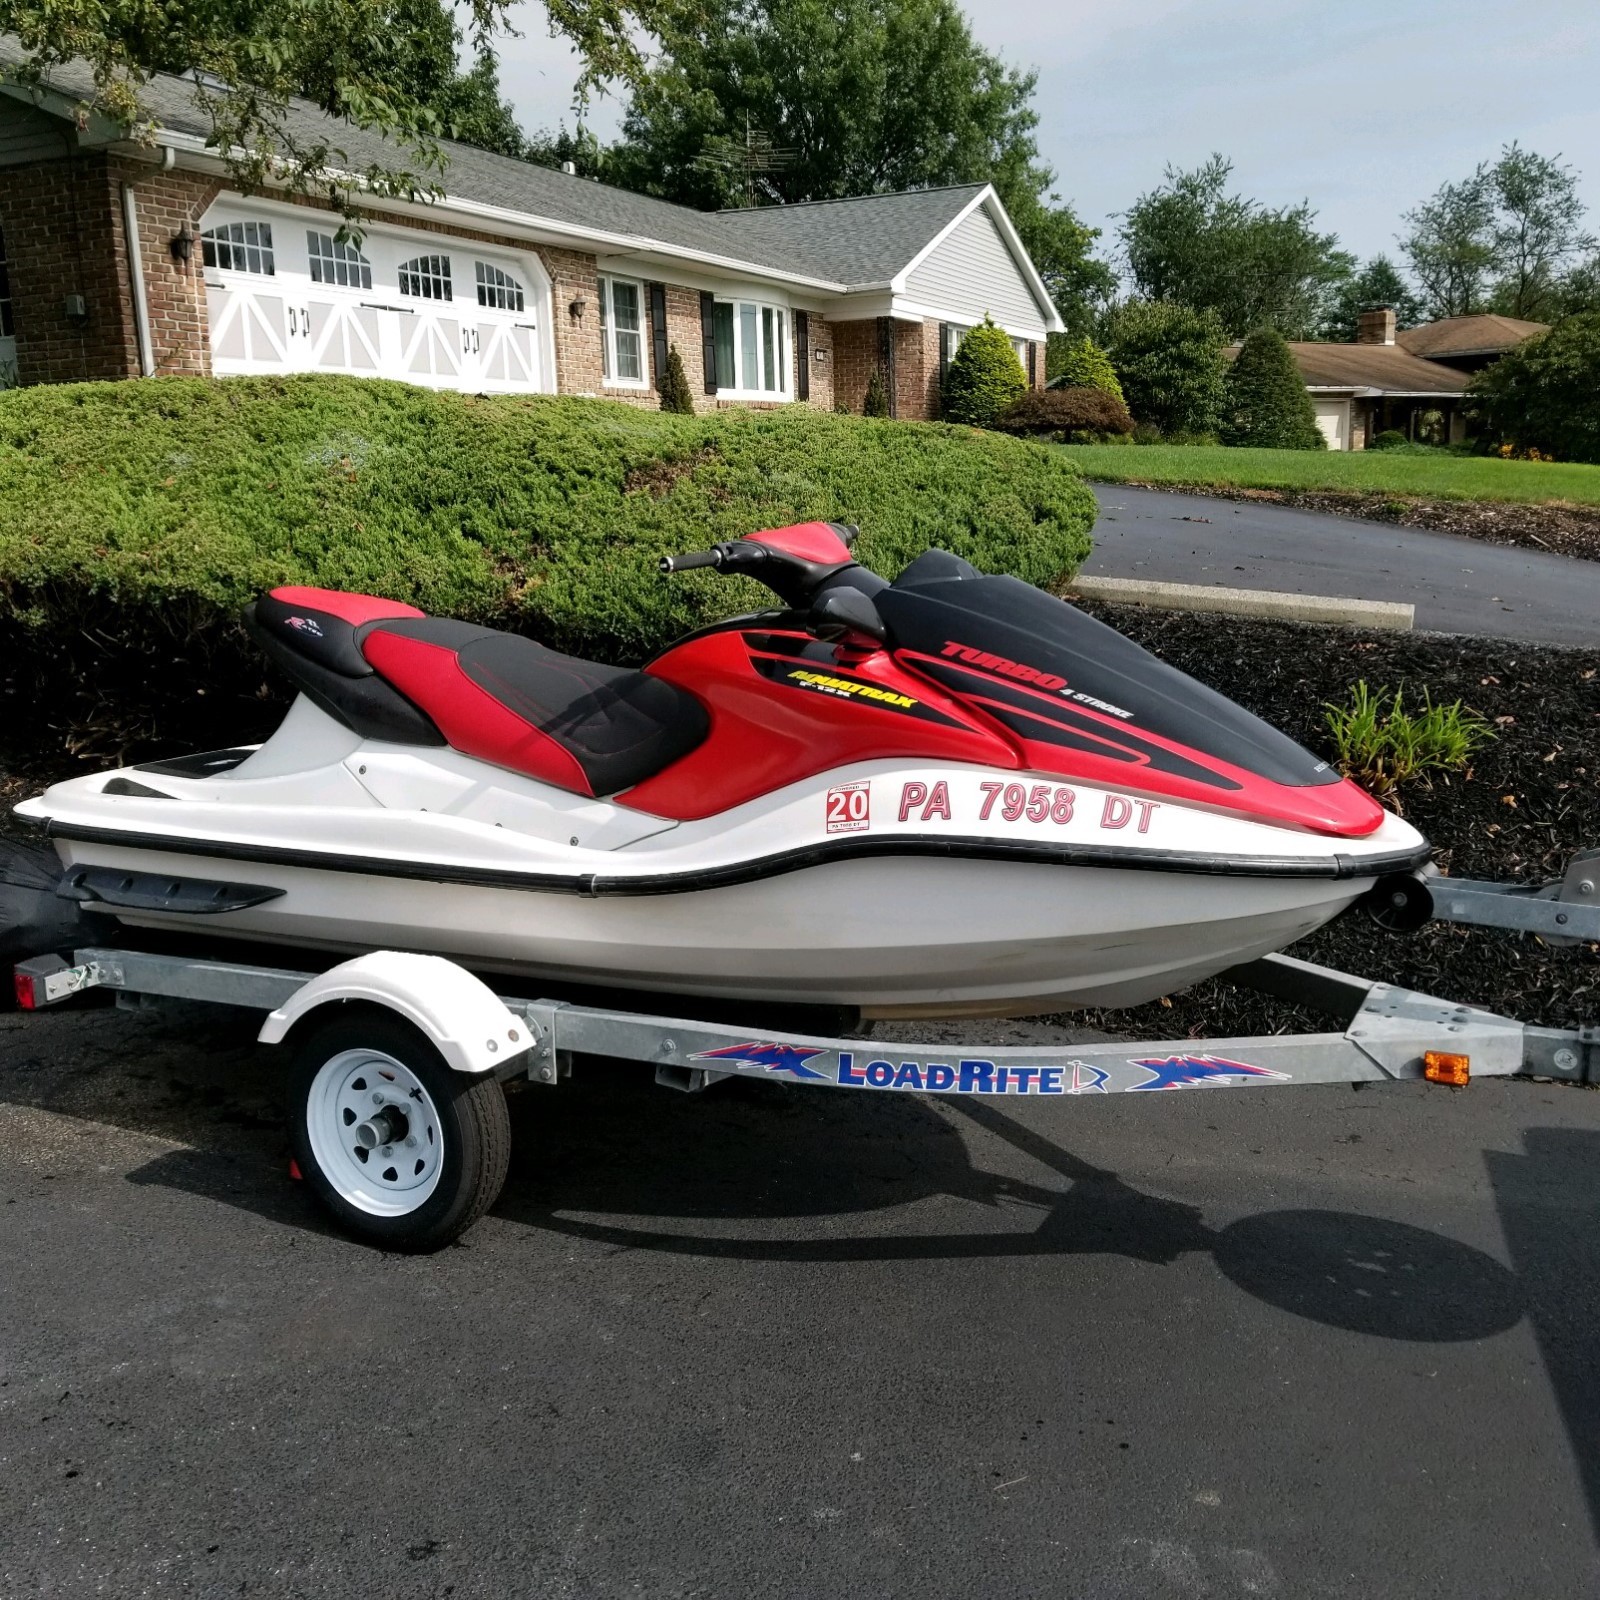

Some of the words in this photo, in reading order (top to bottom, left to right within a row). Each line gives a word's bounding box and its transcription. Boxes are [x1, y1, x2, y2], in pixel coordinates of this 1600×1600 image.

[941, 640, 1068, 690] TURBO
[787, 670, 918, 708] AQUATRAX
[1058, 687, 1075, 696] 4
[1073, 693, 1135, 719] STROKE
[828, 790, 868, 822] 20
[898, 781, 951, 821] PA
[979, 782, 1076, 825] 7958
[1099, 794, 1160, 834] DT
